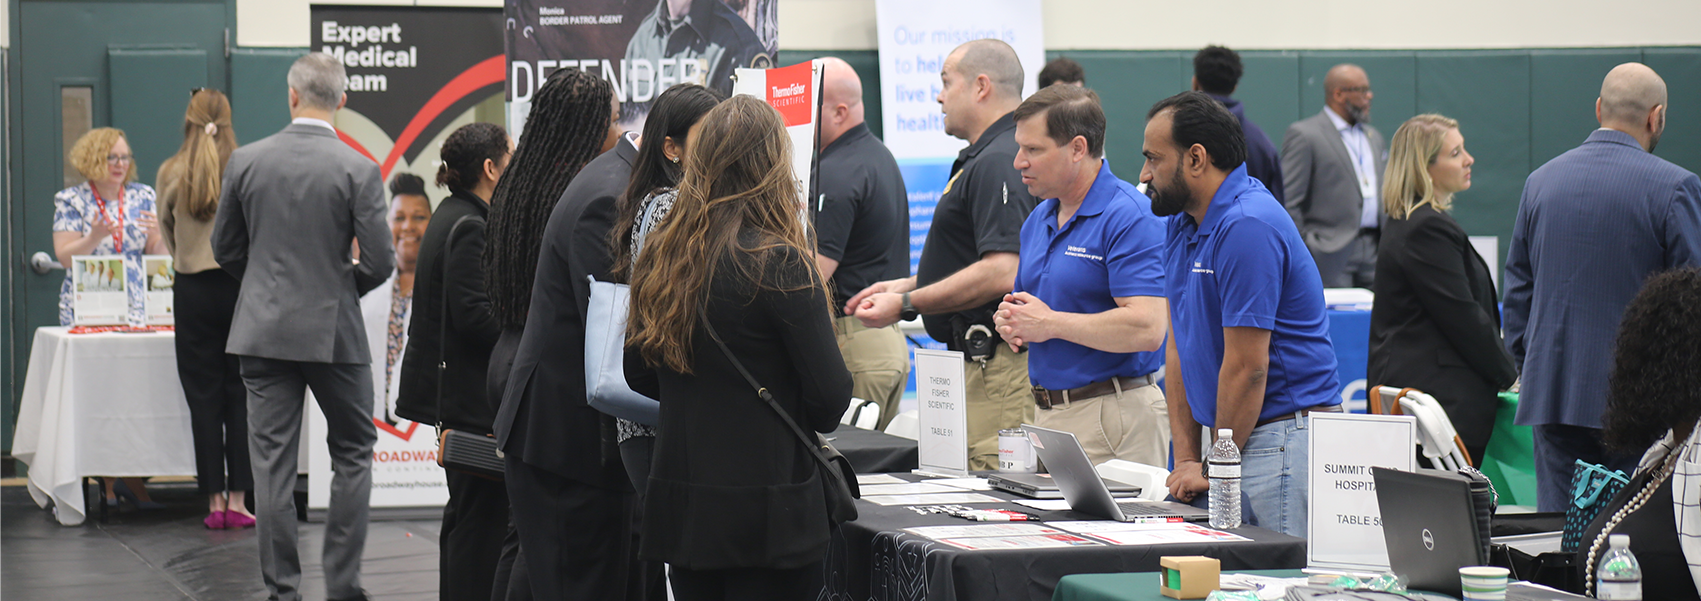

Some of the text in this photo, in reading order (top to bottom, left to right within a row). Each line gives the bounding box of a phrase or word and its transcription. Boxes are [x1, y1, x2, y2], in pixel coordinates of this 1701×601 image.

[539, 6, 565, 15] Monica
[539, 15, 623, 26] BORDER PATROL AGENT
[322, 20, 402, 47] Expert
[893, 25, 1015, 45] Our mission is
[322, 44, 417, 67] Medical
[895, 55, 943, 74] to hel
[895, 84, 925, 102] live
[773, 95, 805, 107] SCIENTIFIC
[929, 376, 951, 386] THERMO
[931, 388, 950, 398] FISHER
[928, 400, 955, 411] SCIENTIFIC
[931, 427, 953, 437] TABLE 51
[1324, 463, 1365, 475] SUMMIT
[1335, 480, 1377, 491] HOSPIT
[1336, 514, 1370, 525] TABLE
